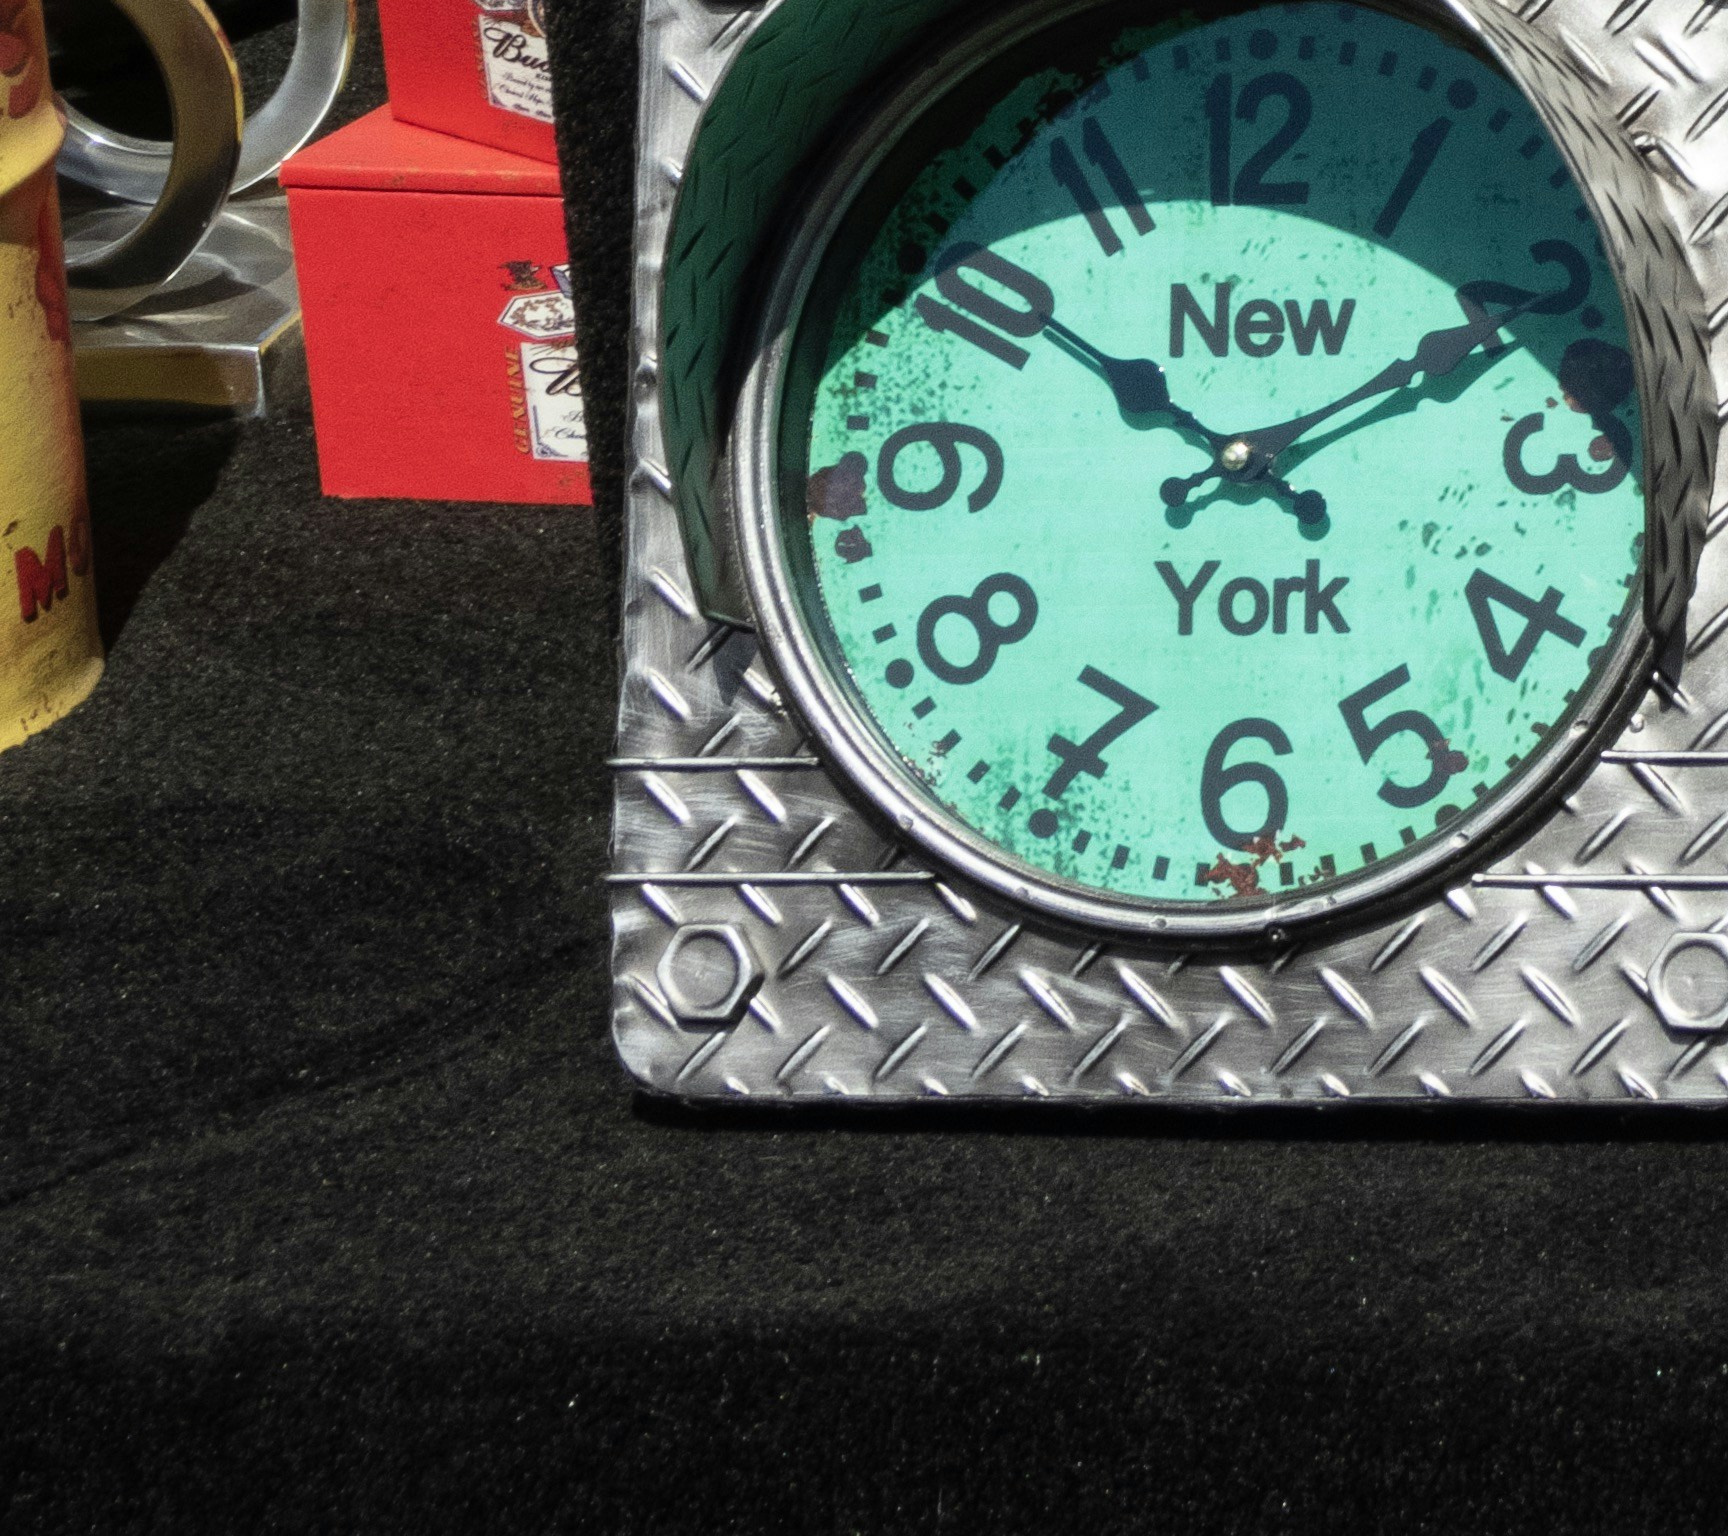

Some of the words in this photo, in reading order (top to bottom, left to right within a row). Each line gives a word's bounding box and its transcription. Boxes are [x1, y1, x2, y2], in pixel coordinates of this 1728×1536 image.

[1049, 115, 1157, 258] 11
[1205, 71, 1315, 207] 12
[1372, 115, 1453, 240] 1
[914, 240, 1055, 373] 10
[1168, 281, 1357, 358] New
[1456, 238, 1593, 359] 2
[876, 421, 1003, 515] 9
[1502, 411, 1632, 497] 3
[916, 572, 1040, 687] 8
[1155, 558, 1352, 638] York
[1464, 567, 1588, 684] 4
[1044, 664, 1161, 801] 7
[1199, 716, 1295, 851] 6
[1338, 663, 1454, 811] 5
